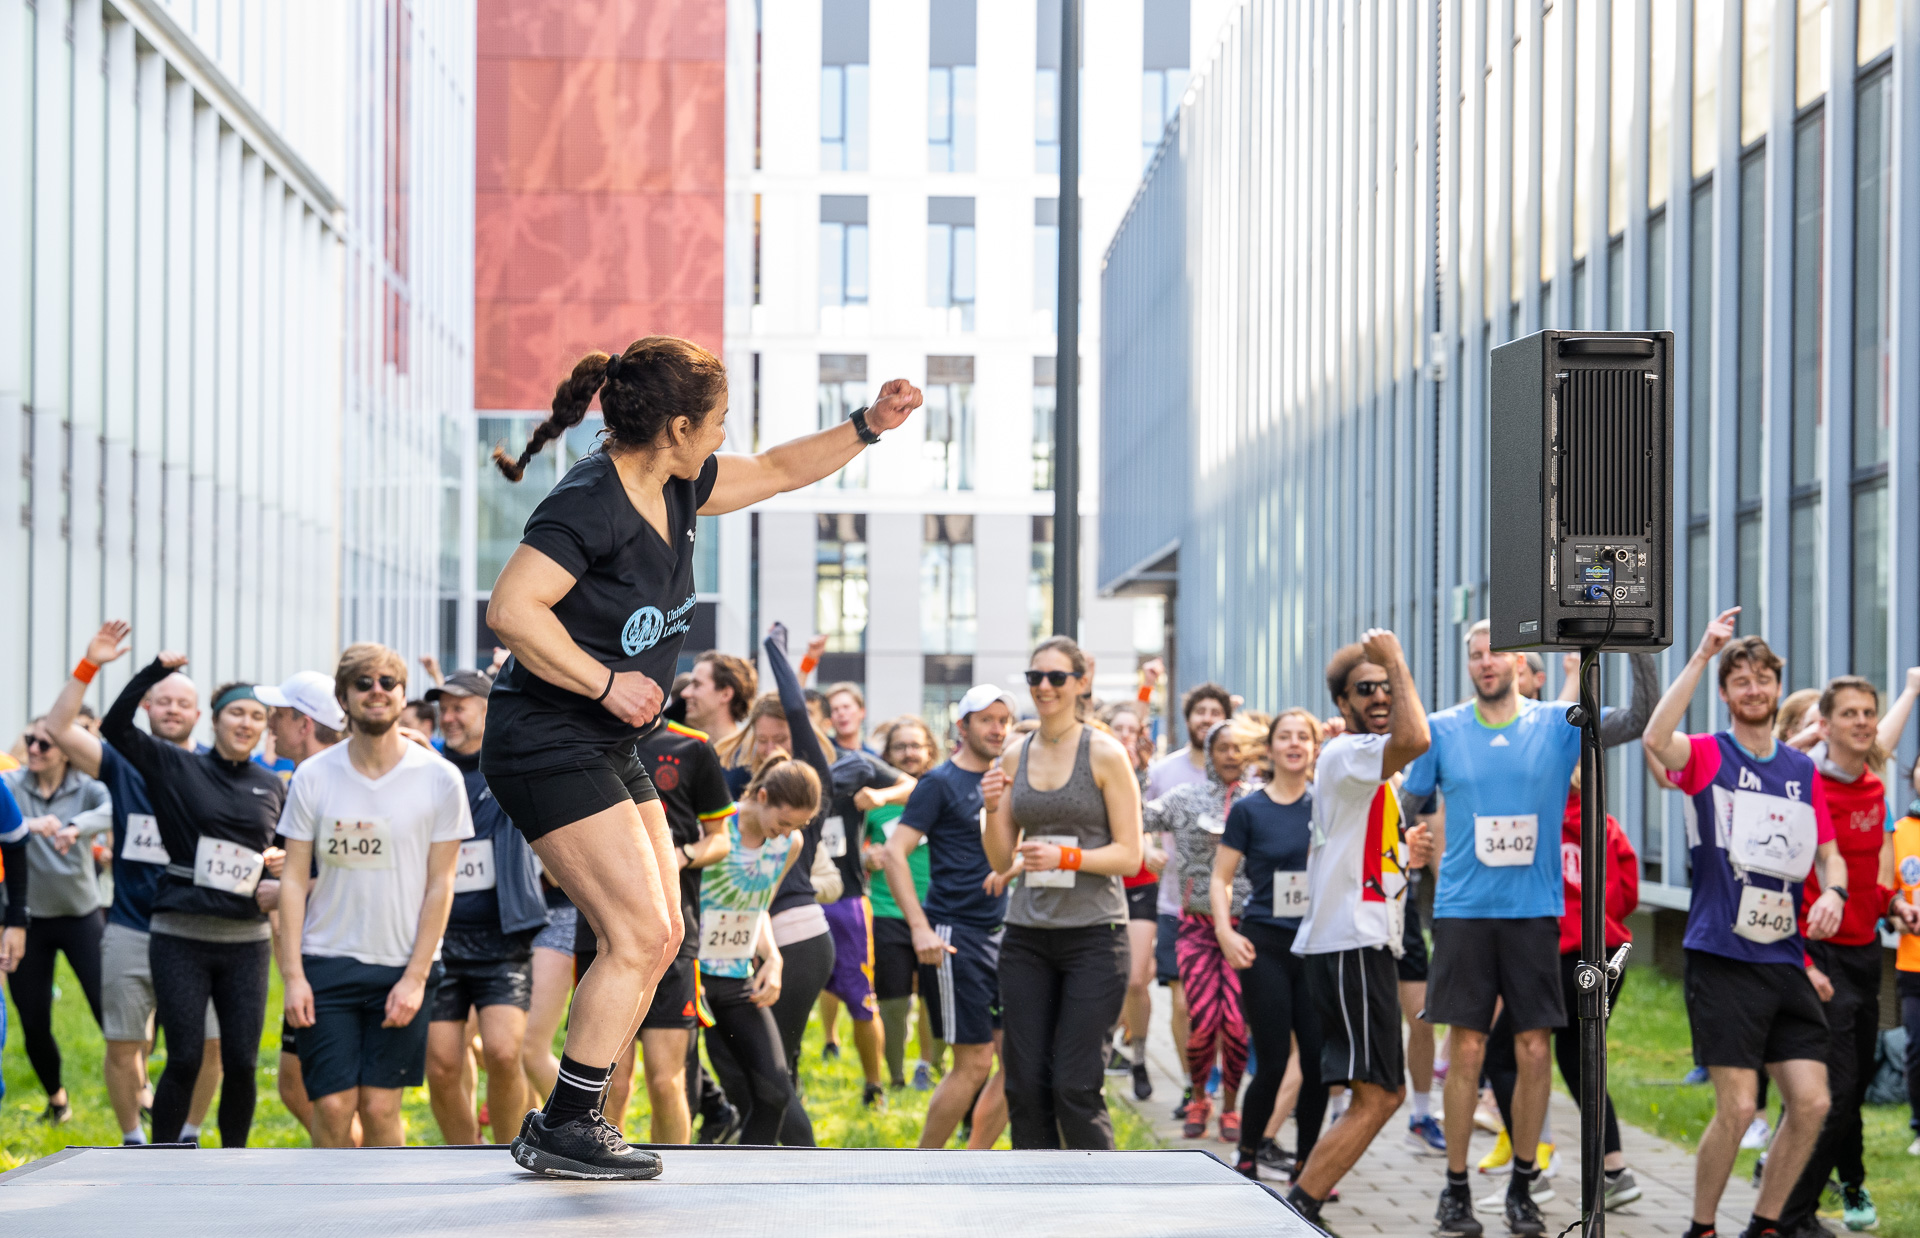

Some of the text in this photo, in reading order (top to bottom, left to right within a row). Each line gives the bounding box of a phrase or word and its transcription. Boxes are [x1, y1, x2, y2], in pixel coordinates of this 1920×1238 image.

[328, 838, 382, 855] 21-02
[1485, 835, 1534, 853] 34-02
[206, 858, 253, 881] 13-02
[456, 862, 485, 878] -01
[1747, 910, 1793, 933] 34-03
[709, 930, 750, 946] 21-03
